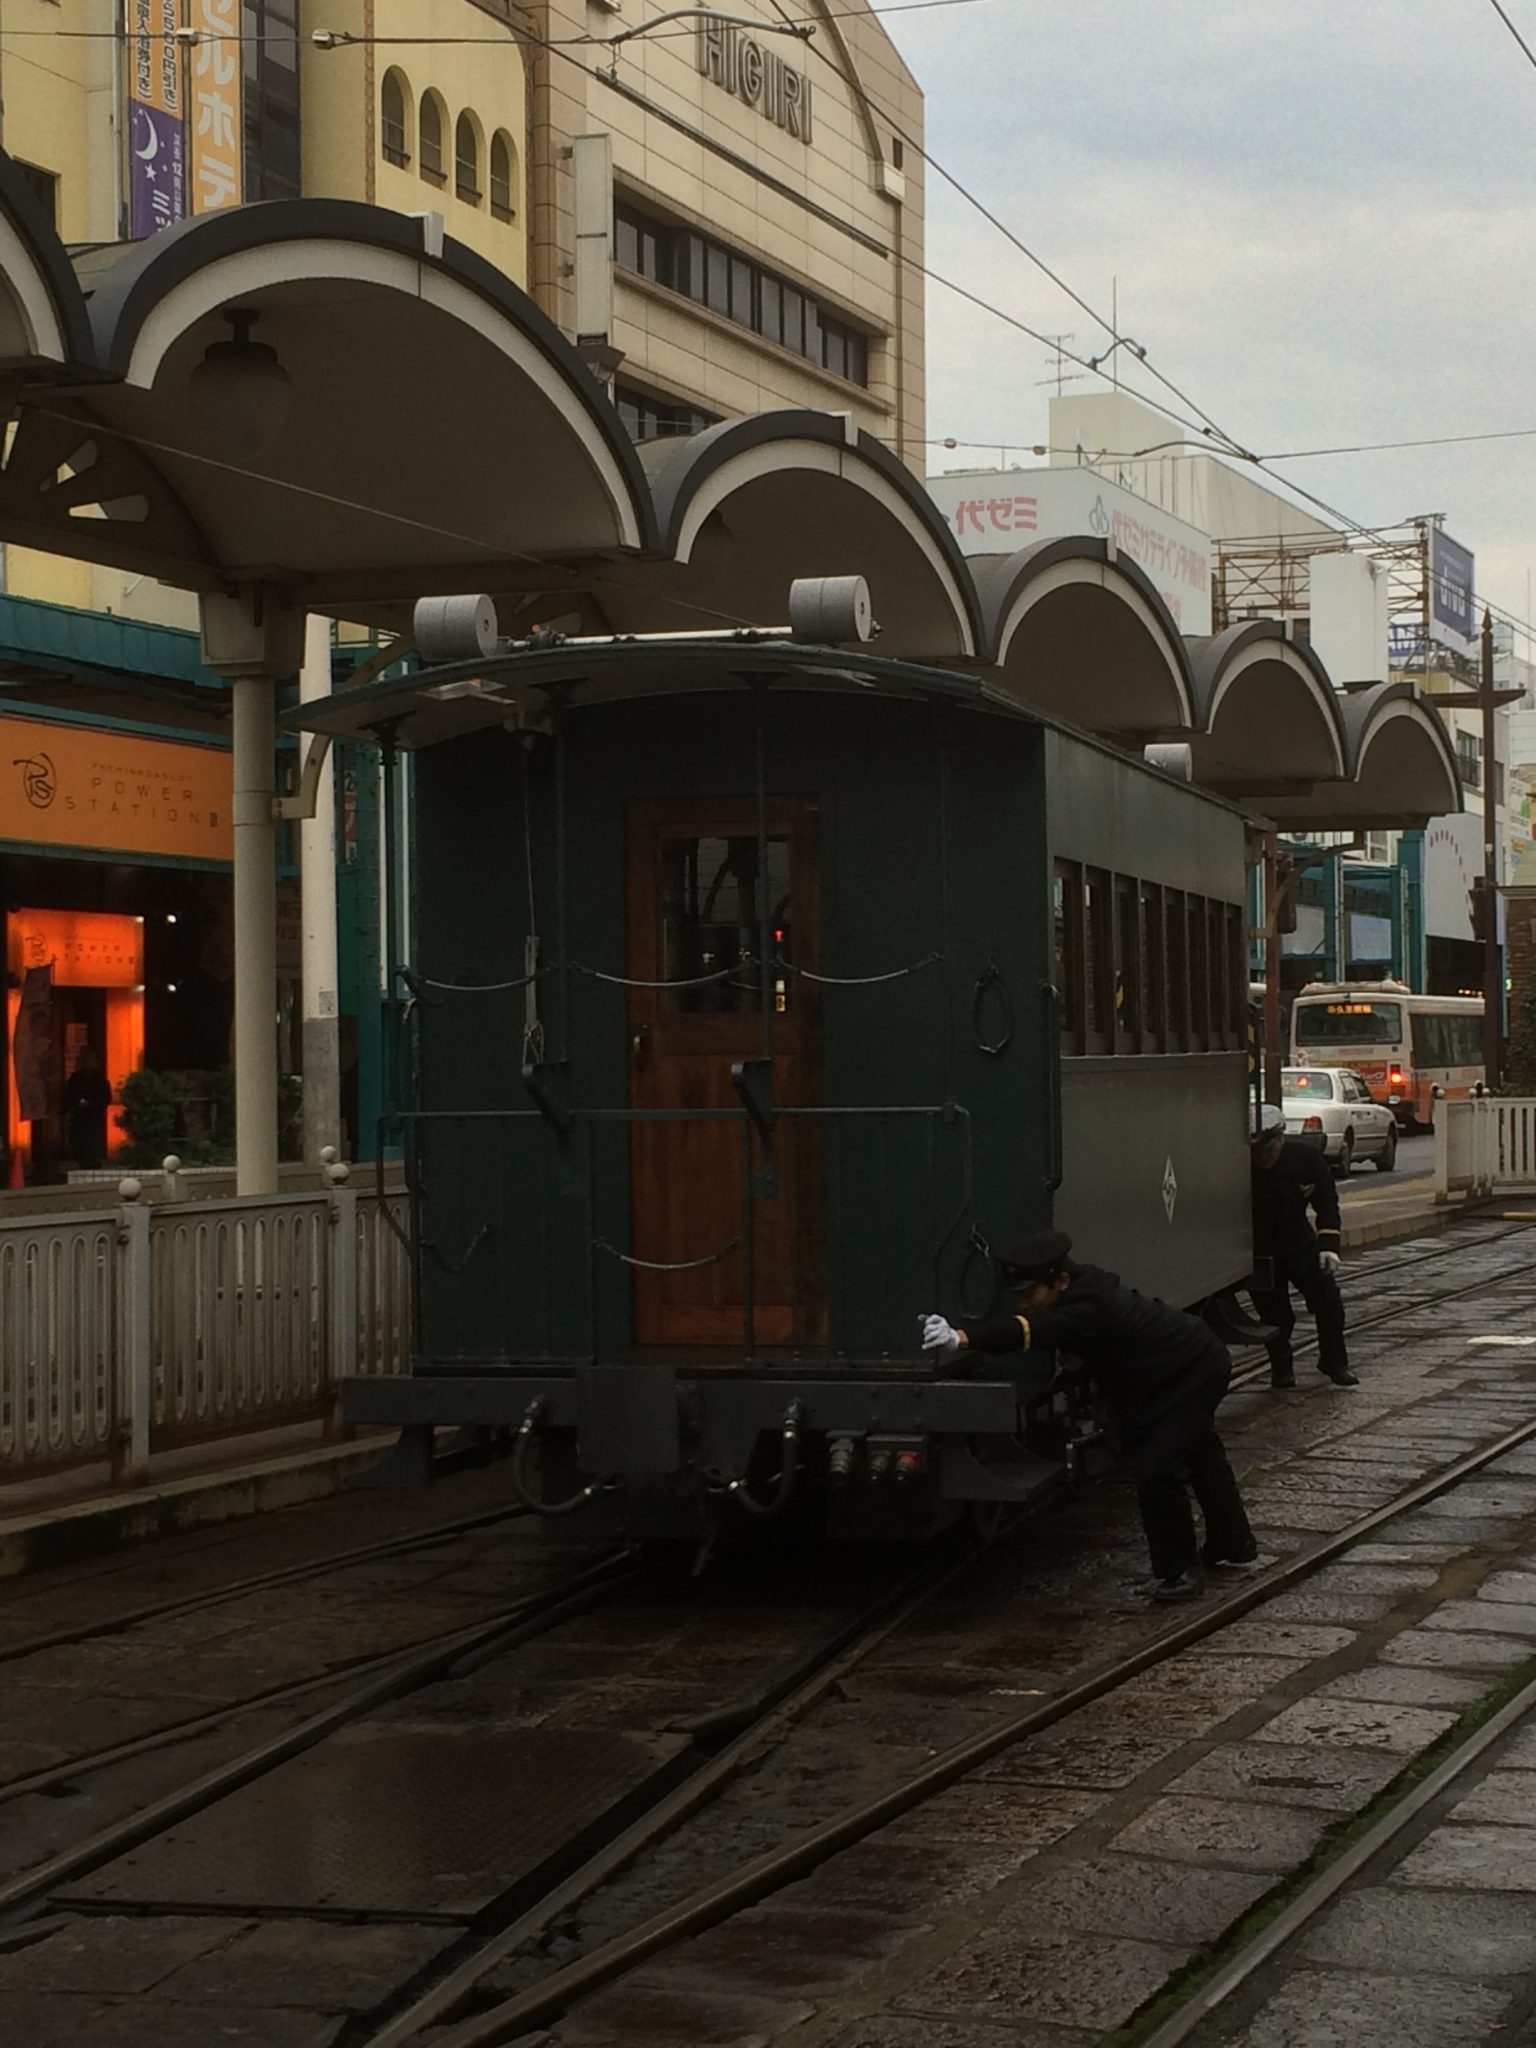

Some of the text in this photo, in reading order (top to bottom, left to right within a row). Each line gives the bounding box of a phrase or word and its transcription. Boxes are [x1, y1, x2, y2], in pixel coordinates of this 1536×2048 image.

[695, 4, 813, 145] HIGIRI
[955, 497, 1038, 535] 代ゼミ
[92, 777, 194, 802] POWER
